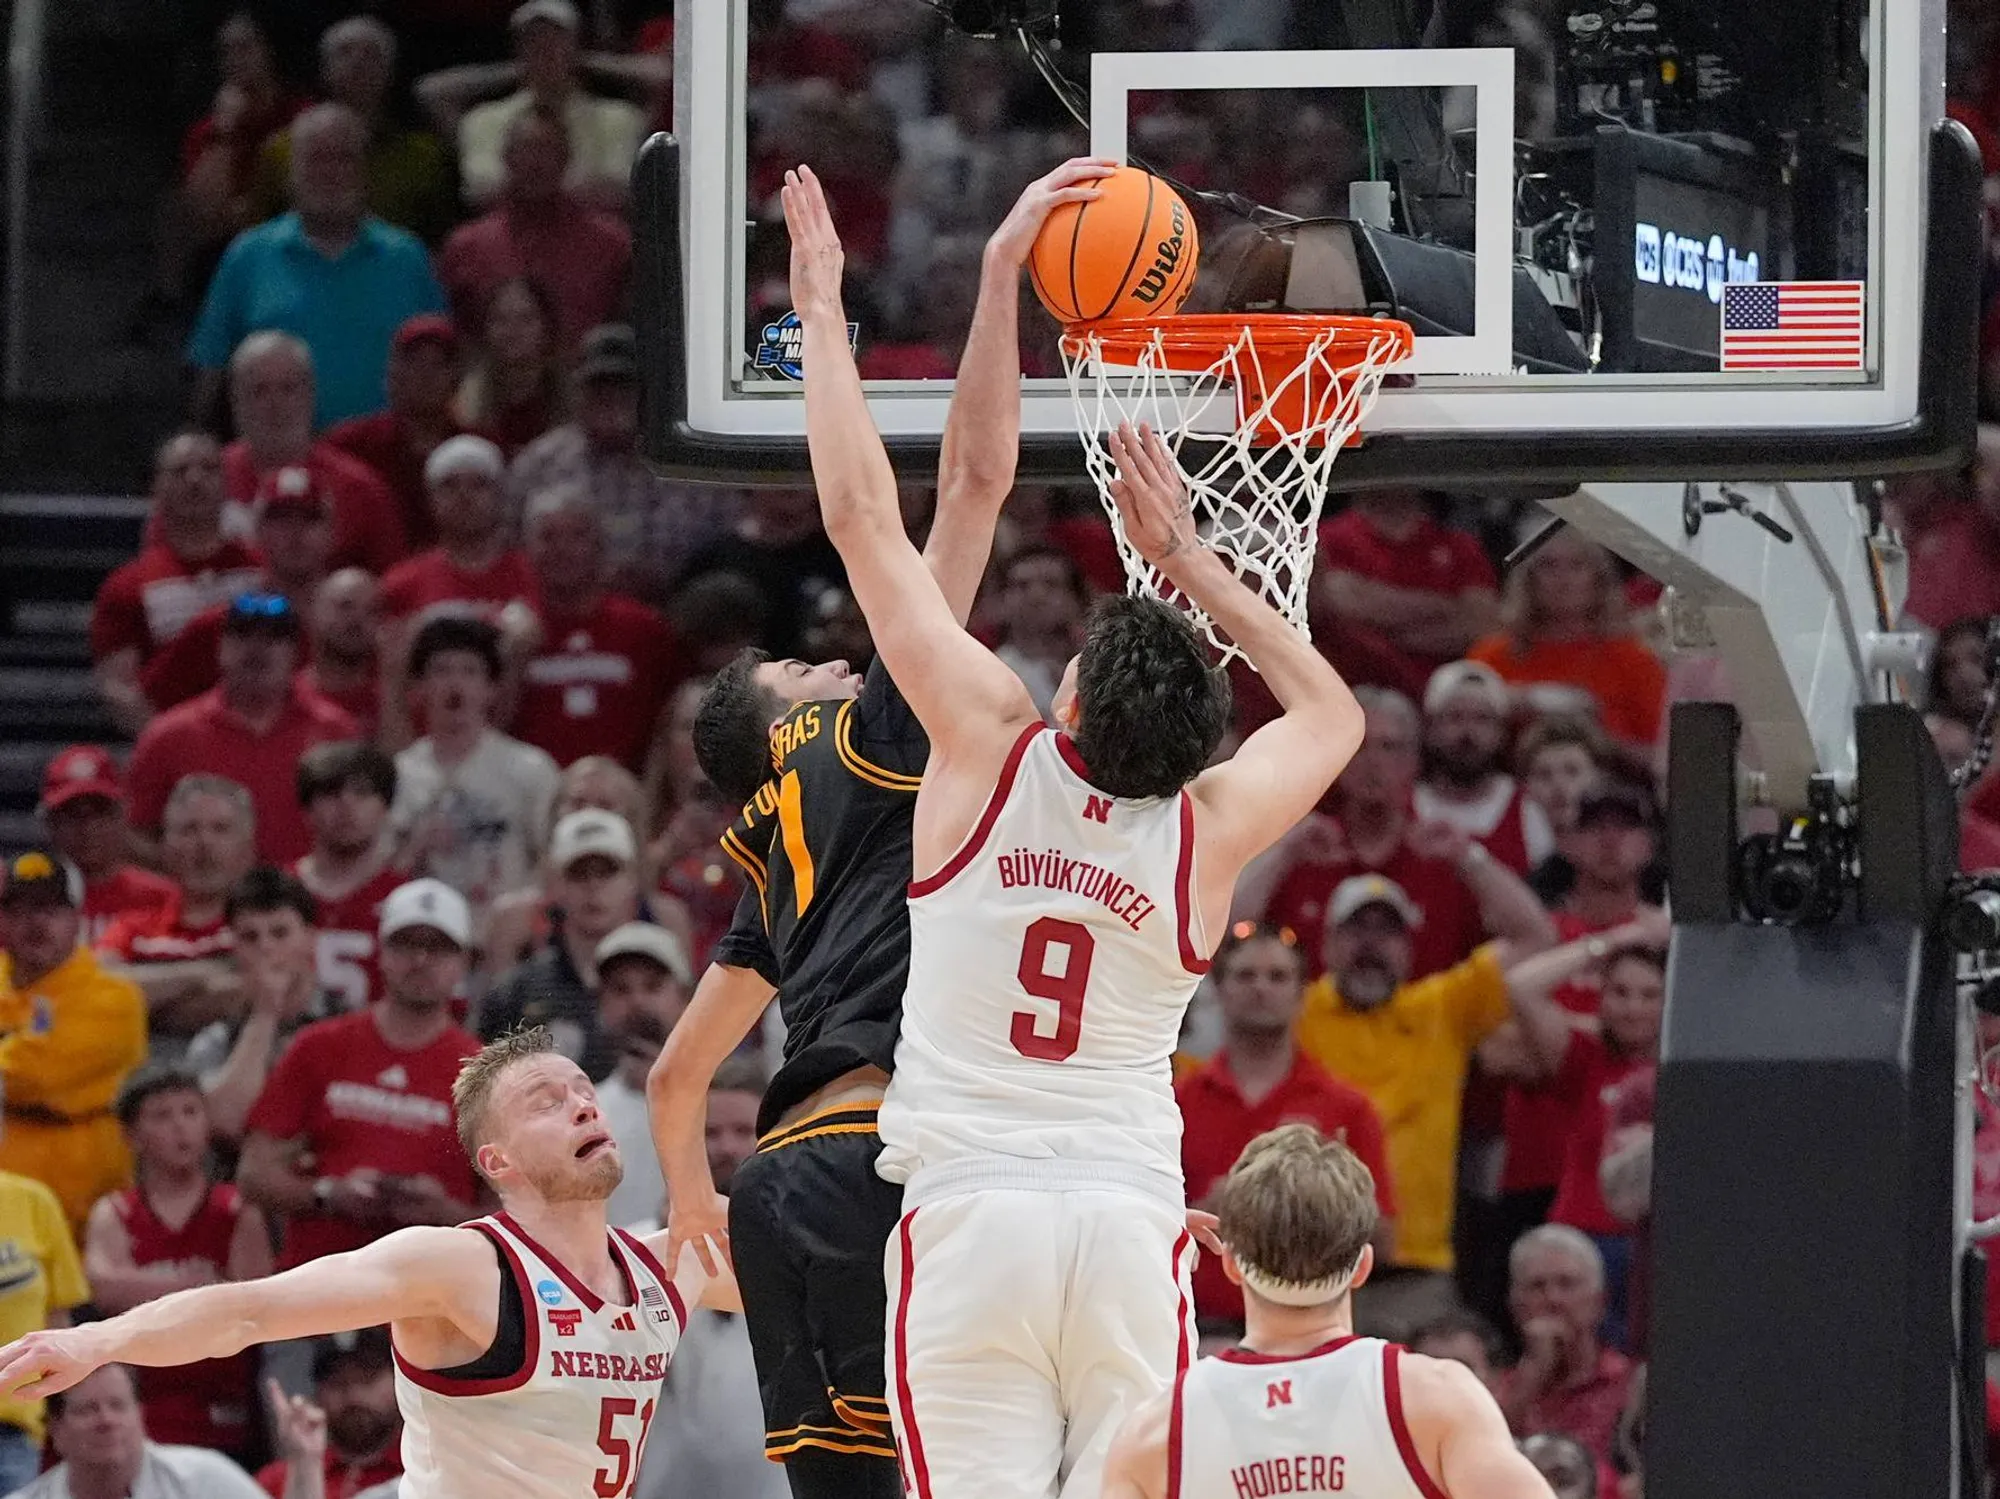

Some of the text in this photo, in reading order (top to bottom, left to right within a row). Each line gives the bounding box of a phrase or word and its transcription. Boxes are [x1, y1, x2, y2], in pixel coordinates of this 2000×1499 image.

[1131, 201, 1185, 303] Wilson
[779, 768, 815, 919] 1
[1082, 794, 1114, 824] N
[998, 848, 1156, 931] BÜYÜKTUNCEL
[1009, 916, 1096, 1062] 9
[1266, 1379, 1293, 1409] N
[1231, 1455, 1345, 1499] HOIBERG
